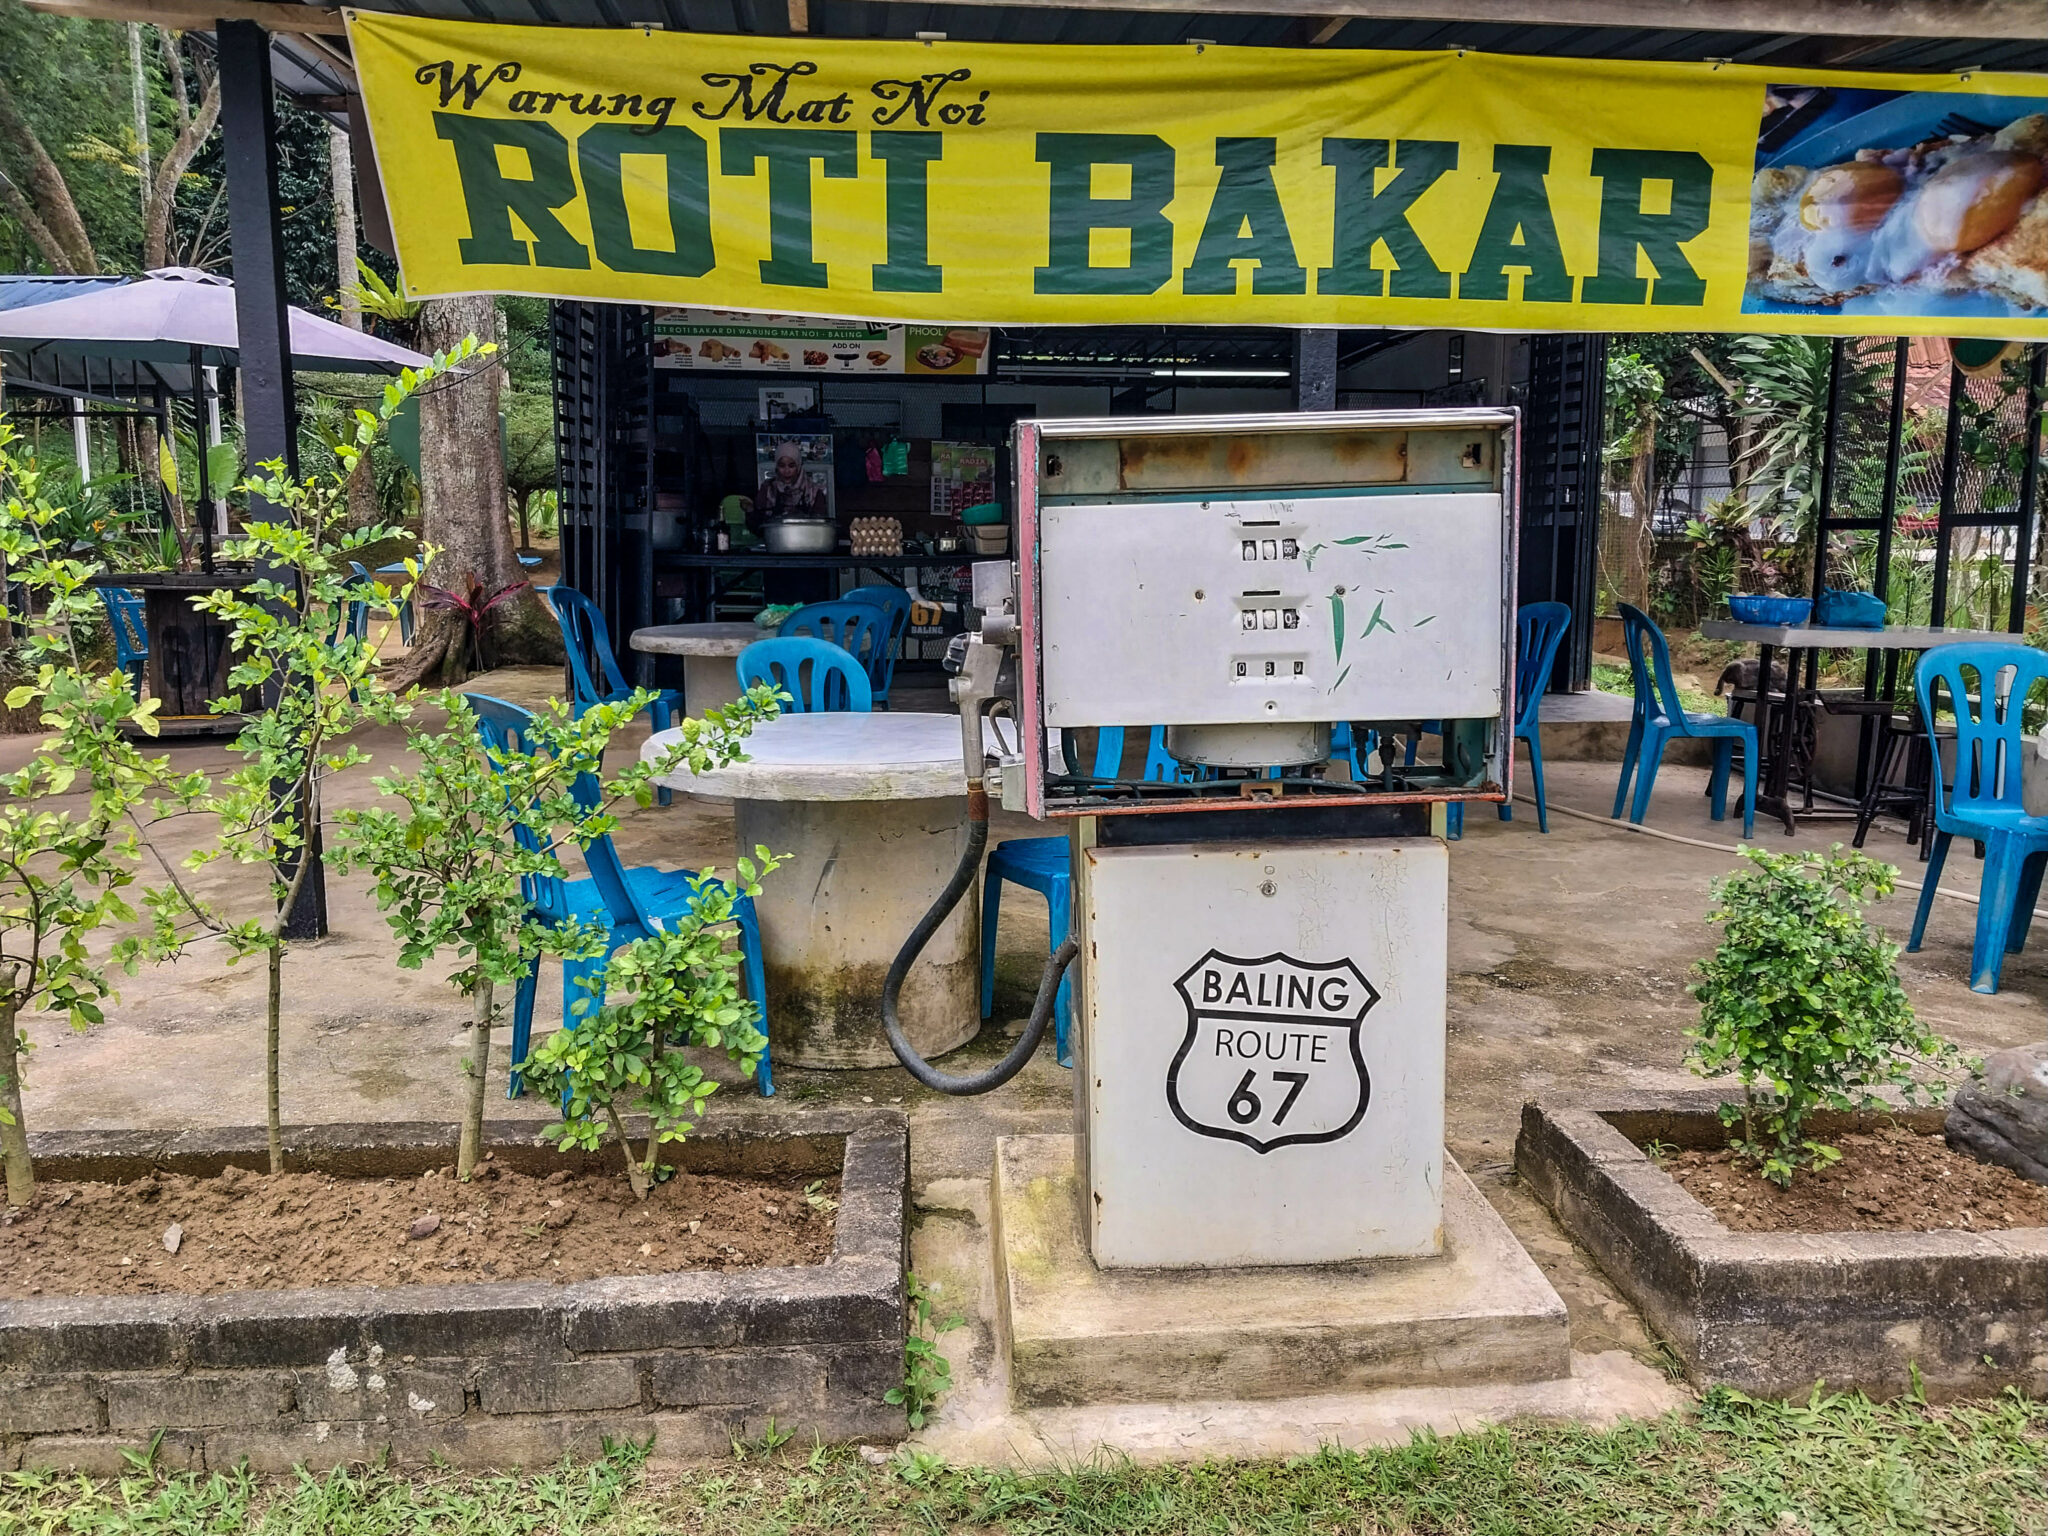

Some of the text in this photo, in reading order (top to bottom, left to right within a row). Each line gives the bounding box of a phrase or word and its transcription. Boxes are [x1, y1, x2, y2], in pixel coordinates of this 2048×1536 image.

[415, 60, 990, 136] Warung Mat Noi
[432, 111, 1714, 306] ROTI BAKAR
[669, 326, 691, 334] ROTI
[693, 327, 724, 335] BAKAR
[726, 327, 736, 335] DI
[738, 328, 779, 337] WARUNG
[781, 329, 799, 337] MAT
[801, 330, 820, 338] NOI
[828, 331, 863, 339] BALING
[832, 342, 848, 350] ADD
[911, 626, 944, 634] BALING
[912, 601, 943, 626] 67
[1202, 969, 1350, 1012] BALING
[1215, 1028, 1328, 1063] ROUTE
[1227, 1068, 1310, 1127] 67
